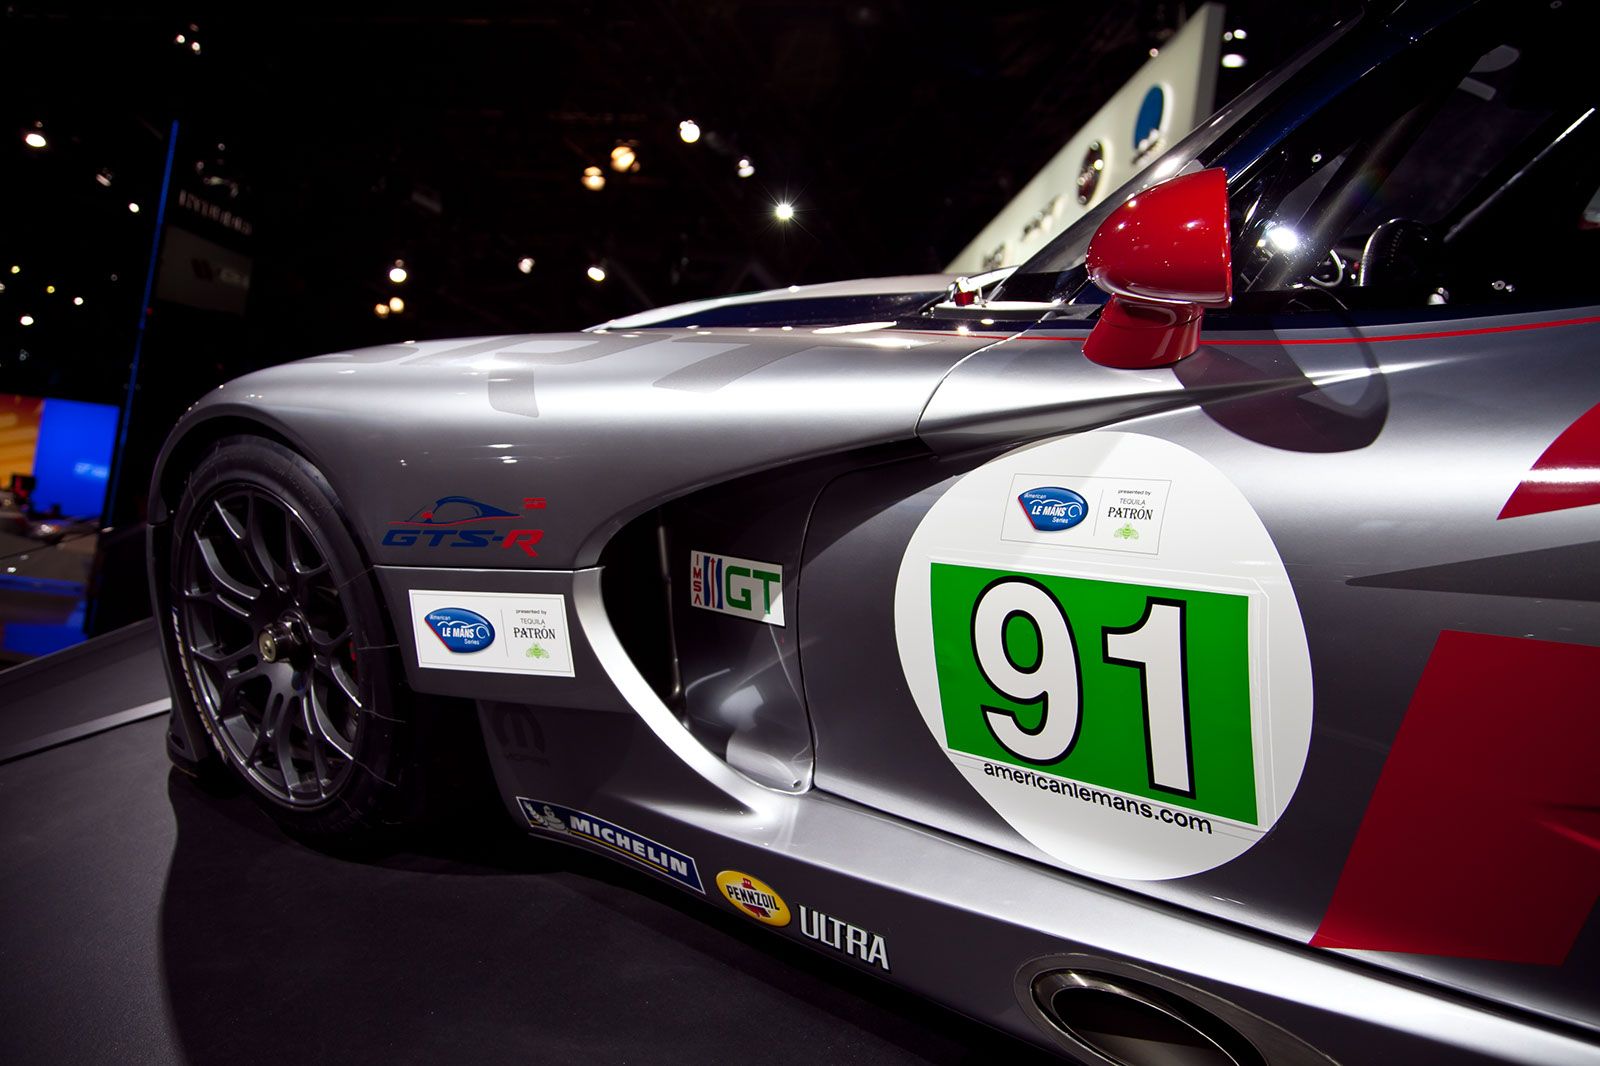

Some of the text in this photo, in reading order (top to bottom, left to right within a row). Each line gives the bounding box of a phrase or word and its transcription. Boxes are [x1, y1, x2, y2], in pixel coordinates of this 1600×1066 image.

[1031, 505, 1067, 517] LE MANS
[1119, 497, 1146, 506] TEQUILA
[1051, 516, 1069, 524] Series
[1107, 505, 1154, 520] PATRÓN
[381, 529, 544, 558] GTS-R
[692, 553, 703, 606] IMSA
[725, 565, 781, 615] GT
[520, 617, 546, 625] TEQUILA
[442, 627, 475, 639] LE MANS
[463, 638, 480, 646] Series
[513, 625, 556, 640] PATRÓN
[969, 575, 1197, 800] 91
[983, 762, 1213, 835] americanlemans.com
[568, 815, 688, 877] MICHELIN
[725, 884, 781, 911] PENNZOIL
[799, 904, 890, 971] ULTRA
